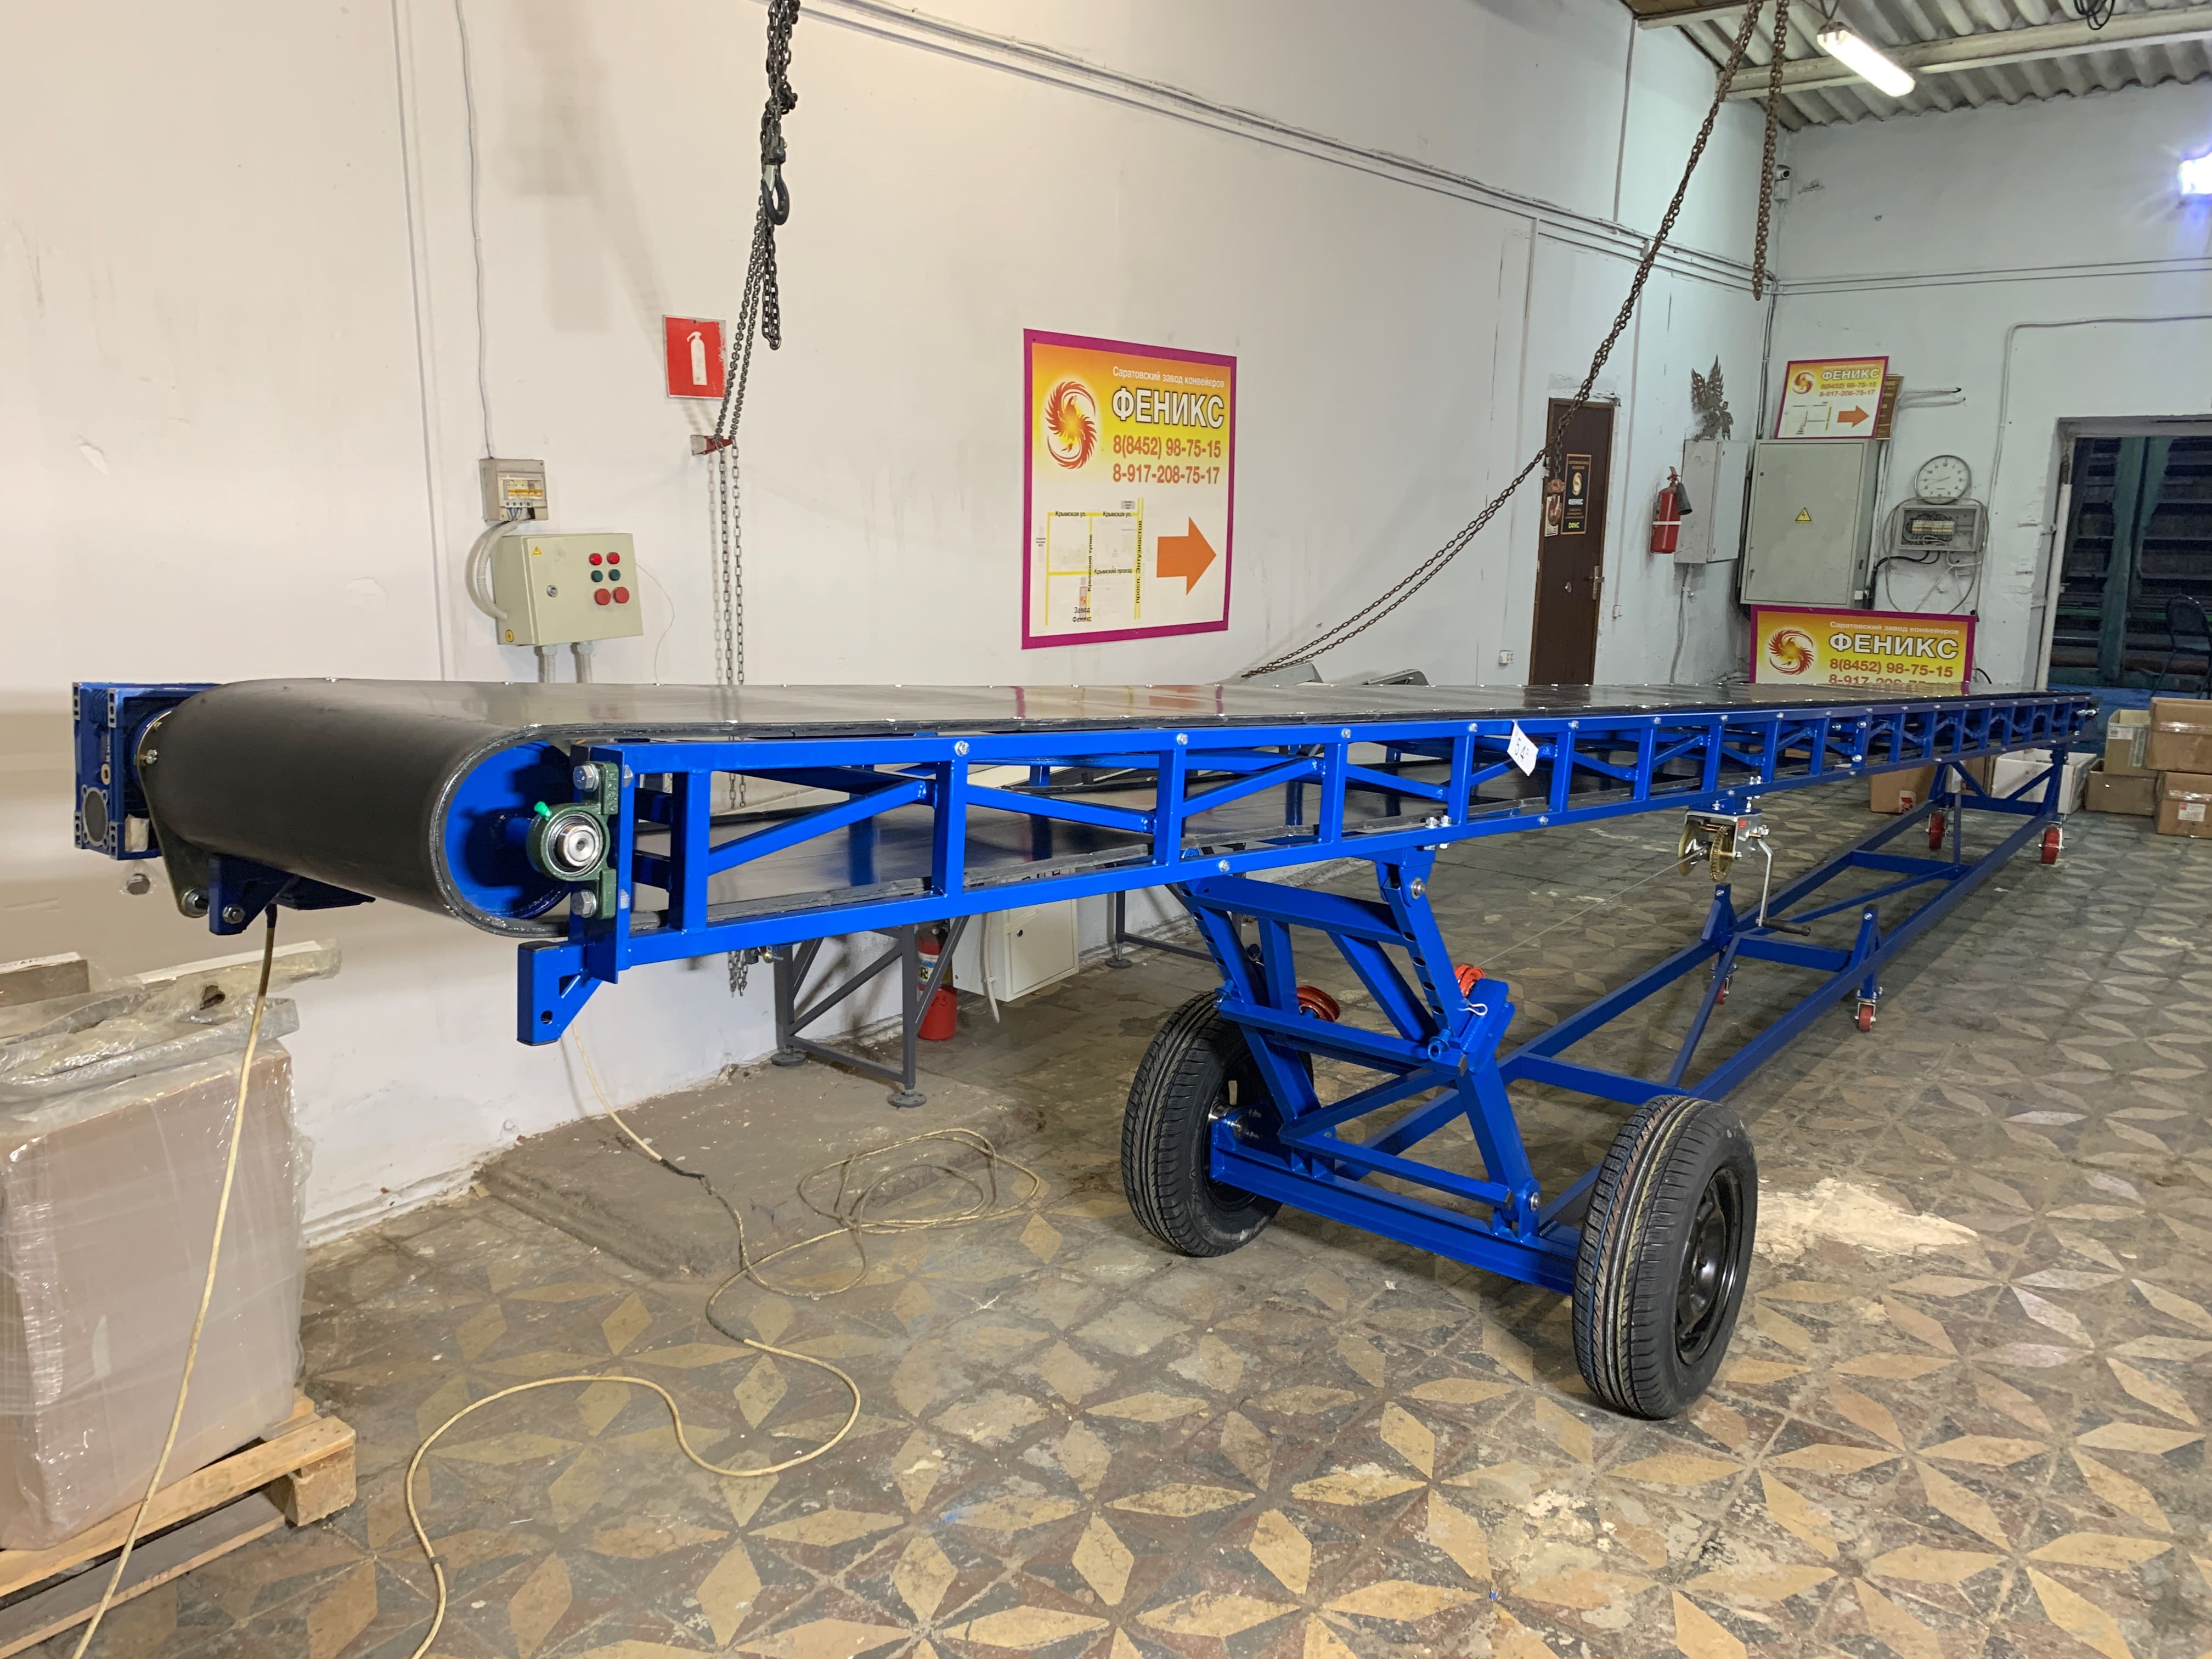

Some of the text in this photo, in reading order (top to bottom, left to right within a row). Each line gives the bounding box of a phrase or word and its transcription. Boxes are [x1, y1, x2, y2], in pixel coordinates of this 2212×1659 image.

[1113, 366, 1224, 390] Саратовский завод конвейеров
[1821, 368, 1881, 381] ФЕНИКС
[1112, 386, 1224, 429] ФЕНИКС
[1113, 435, 1221, 460] 8(8452) 98-75-15
[1113, 463, 1220, 484] 8-917-208-75-17
[1830, 621, 1882, 631] Саратовский
[1910, 627, 1959, 635] конвейеров
[1829, 632, 1959, 659] ФЕНИКС
[1830, 658, 1953, 678] 8(8452) 98-75-15
